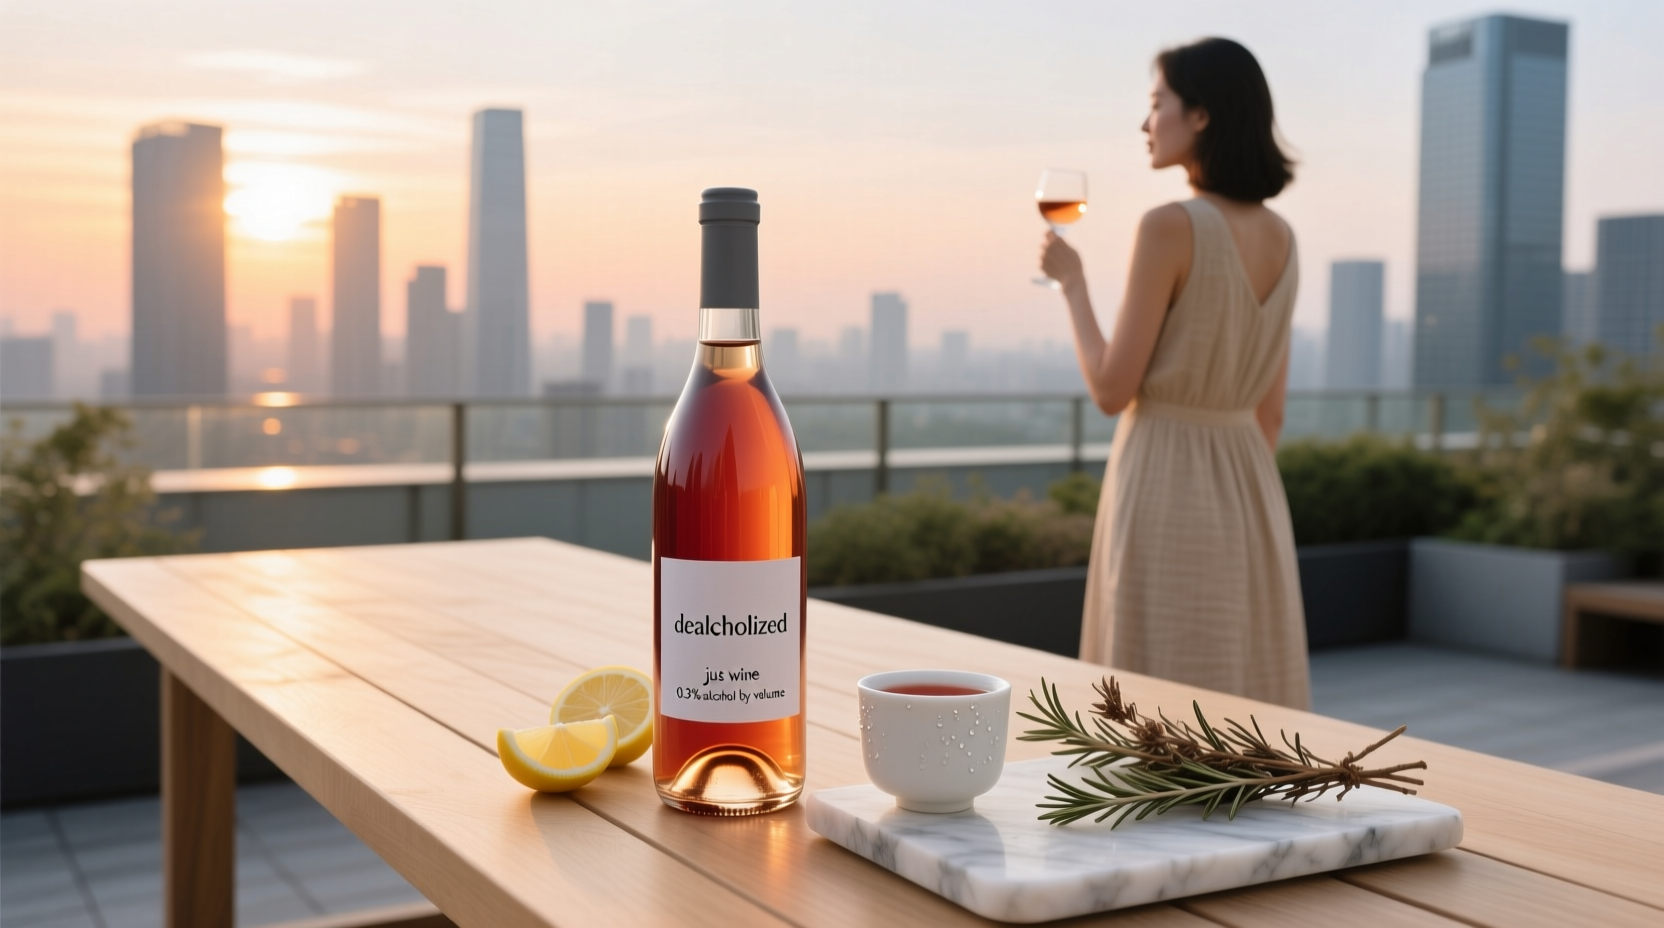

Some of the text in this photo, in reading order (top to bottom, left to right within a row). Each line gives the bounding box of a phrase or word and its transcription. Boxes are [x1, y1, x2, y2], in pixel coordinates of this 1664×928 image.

[675, 613, 787, 636] dealcholized
[702, 667, 760, 686] jus wine
[739, 688, 751, 704] by
